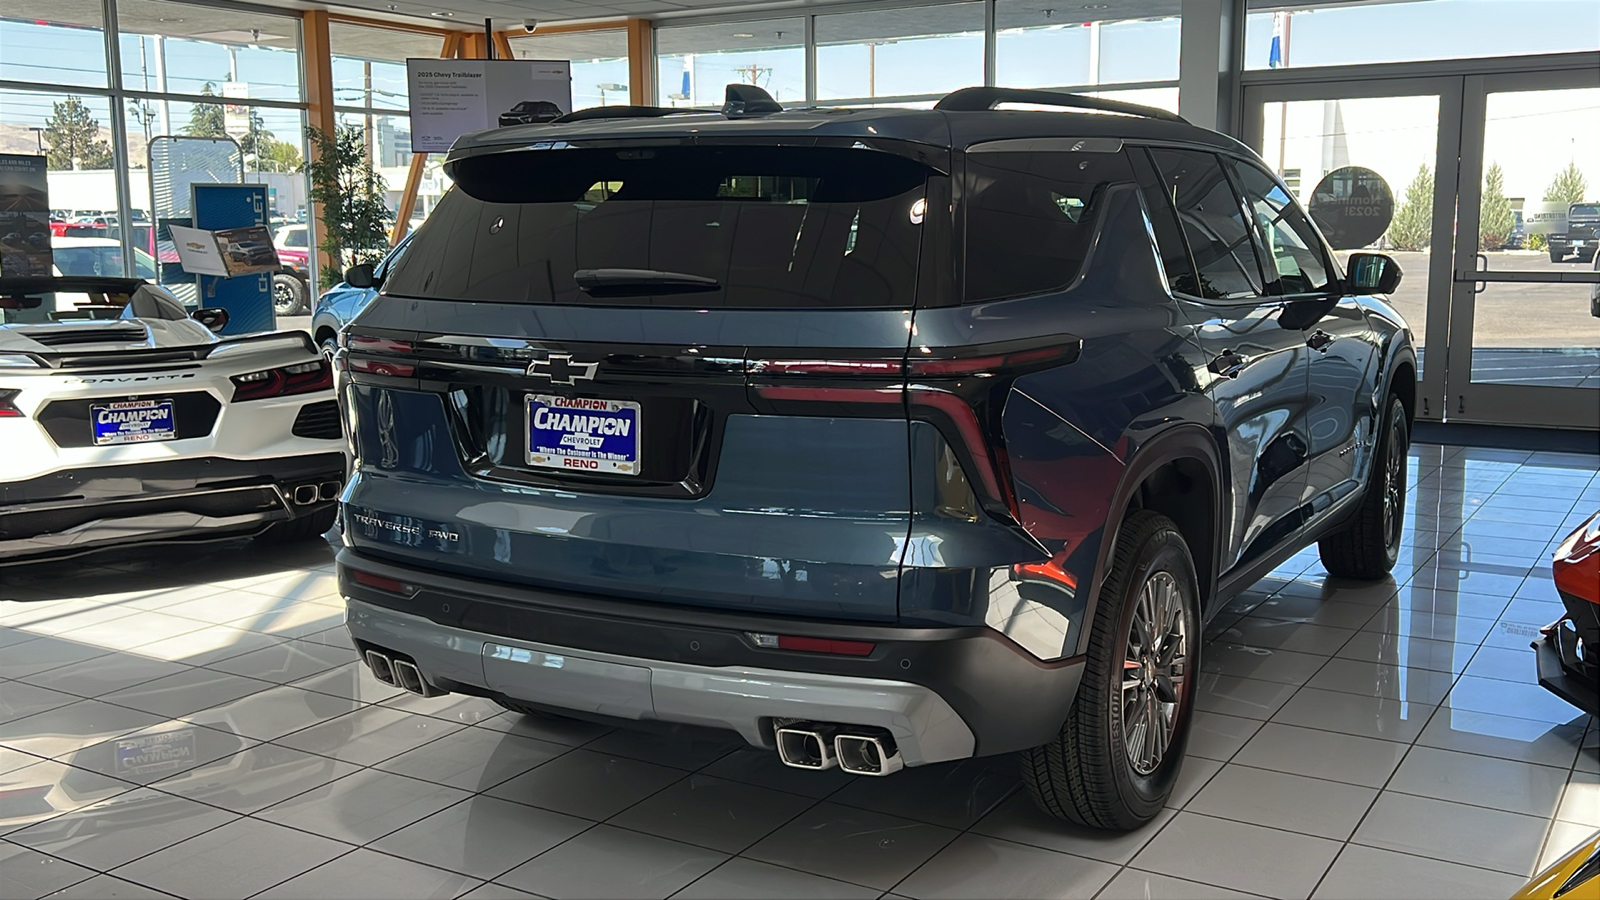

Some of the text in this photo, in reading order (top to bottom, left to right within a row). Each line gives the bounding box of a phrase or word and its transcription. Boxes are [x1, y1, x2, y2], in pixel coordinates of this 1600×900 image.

[433, 71, 451, 79] Chevy
[63, 373, 196, 384] CORVETTE
[112, 401, 152, 409] CHAMPION
[554, 397, 608, 411] CHAMPION
[97, 408, 169, 424] CHAMPION
[121, 421, 150, 429] CHEVROLET
[533, 407, 631, 437] CHAMPION
[123, 434, 150, 442] RENO
[563, 436, 600, 446] CHEVROLET
[536, 446, 556, 454] "Where
[556, 447, 566, 455] The
[567, 448, 592, 457] Customer
[597, 451, 607, 459] The
[563, 458, 599, 469] RENO
[353, 513, 420, 536] TRAVERSE
